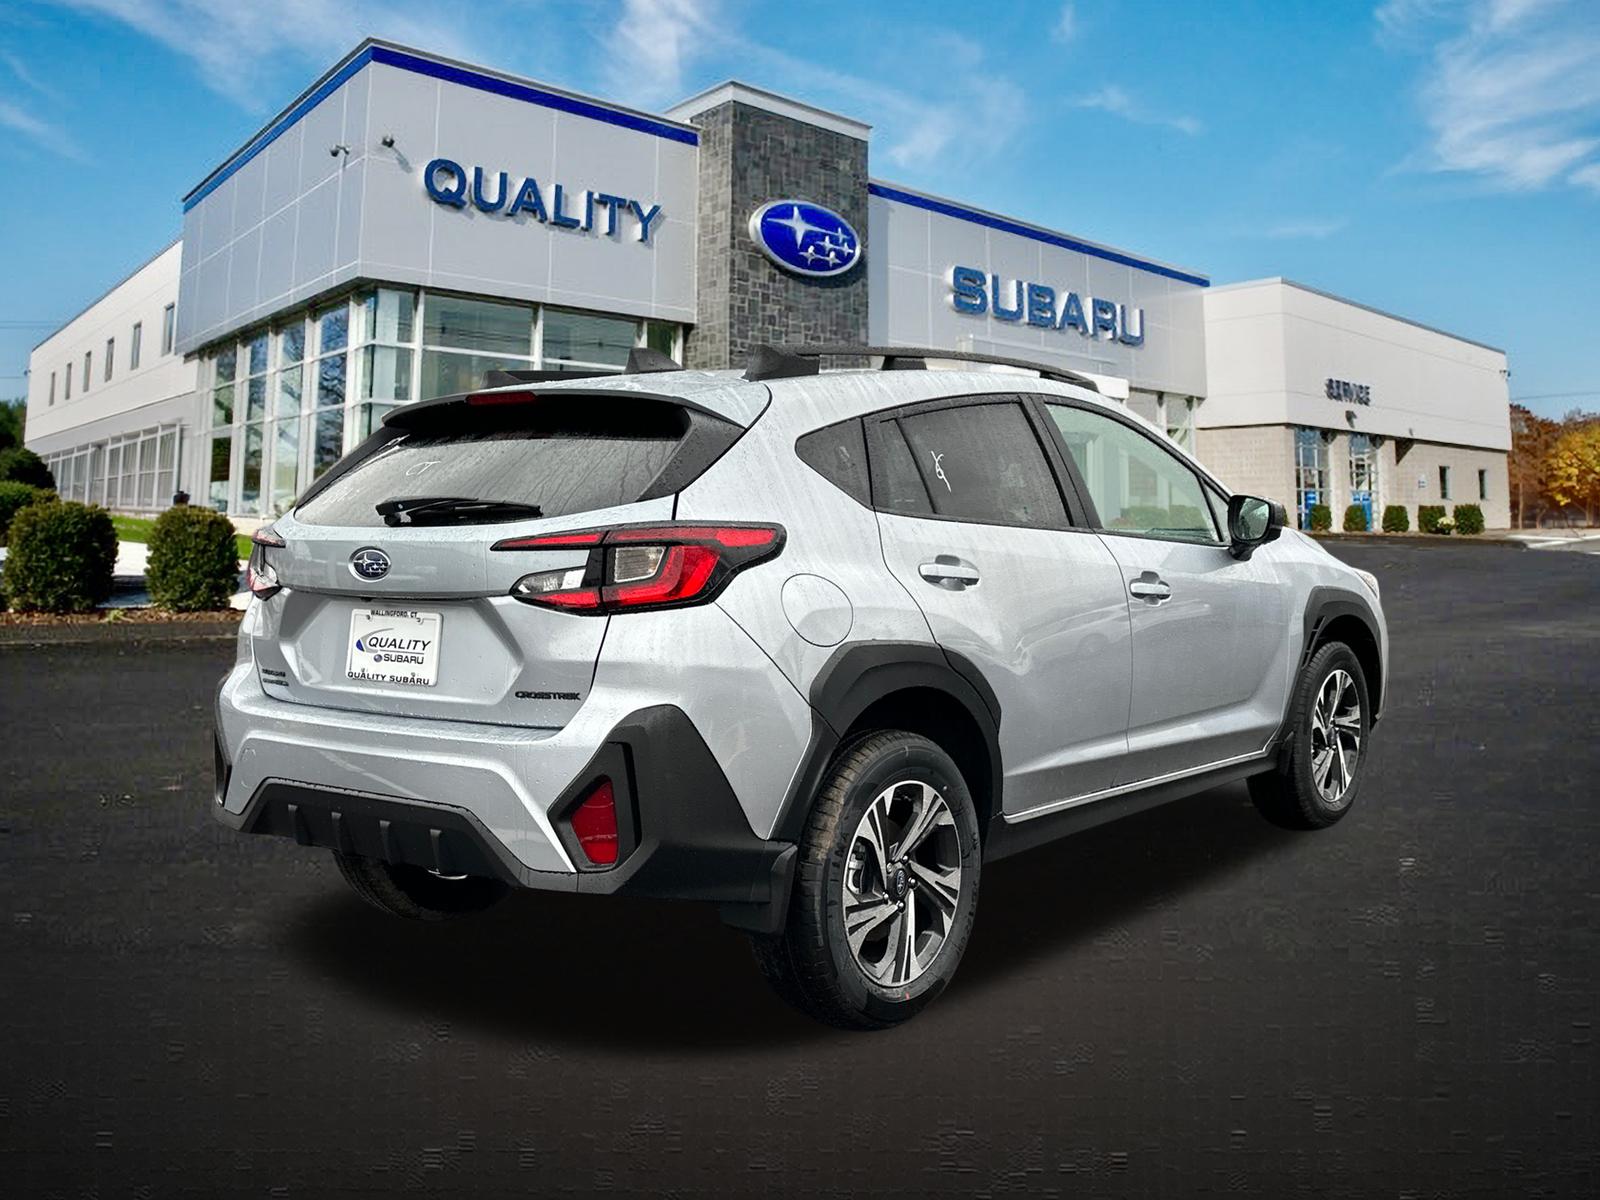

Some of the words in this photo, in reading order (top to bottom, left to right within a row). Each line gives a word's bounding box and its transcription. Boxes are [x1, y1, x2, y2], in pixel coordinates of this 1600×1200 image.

[424, 157, 662, 242] QUALITY
[951, 264, 1145, 347] SUBARU
[368, 636, 431, 651] QUALITY
[383, 653, 425, 665] SUBARU
[347, 671, 387, 681] QUALITY
[389, 674, 430, 686] SUBARU
[514, 690, 581, 701] CROSSTREK
